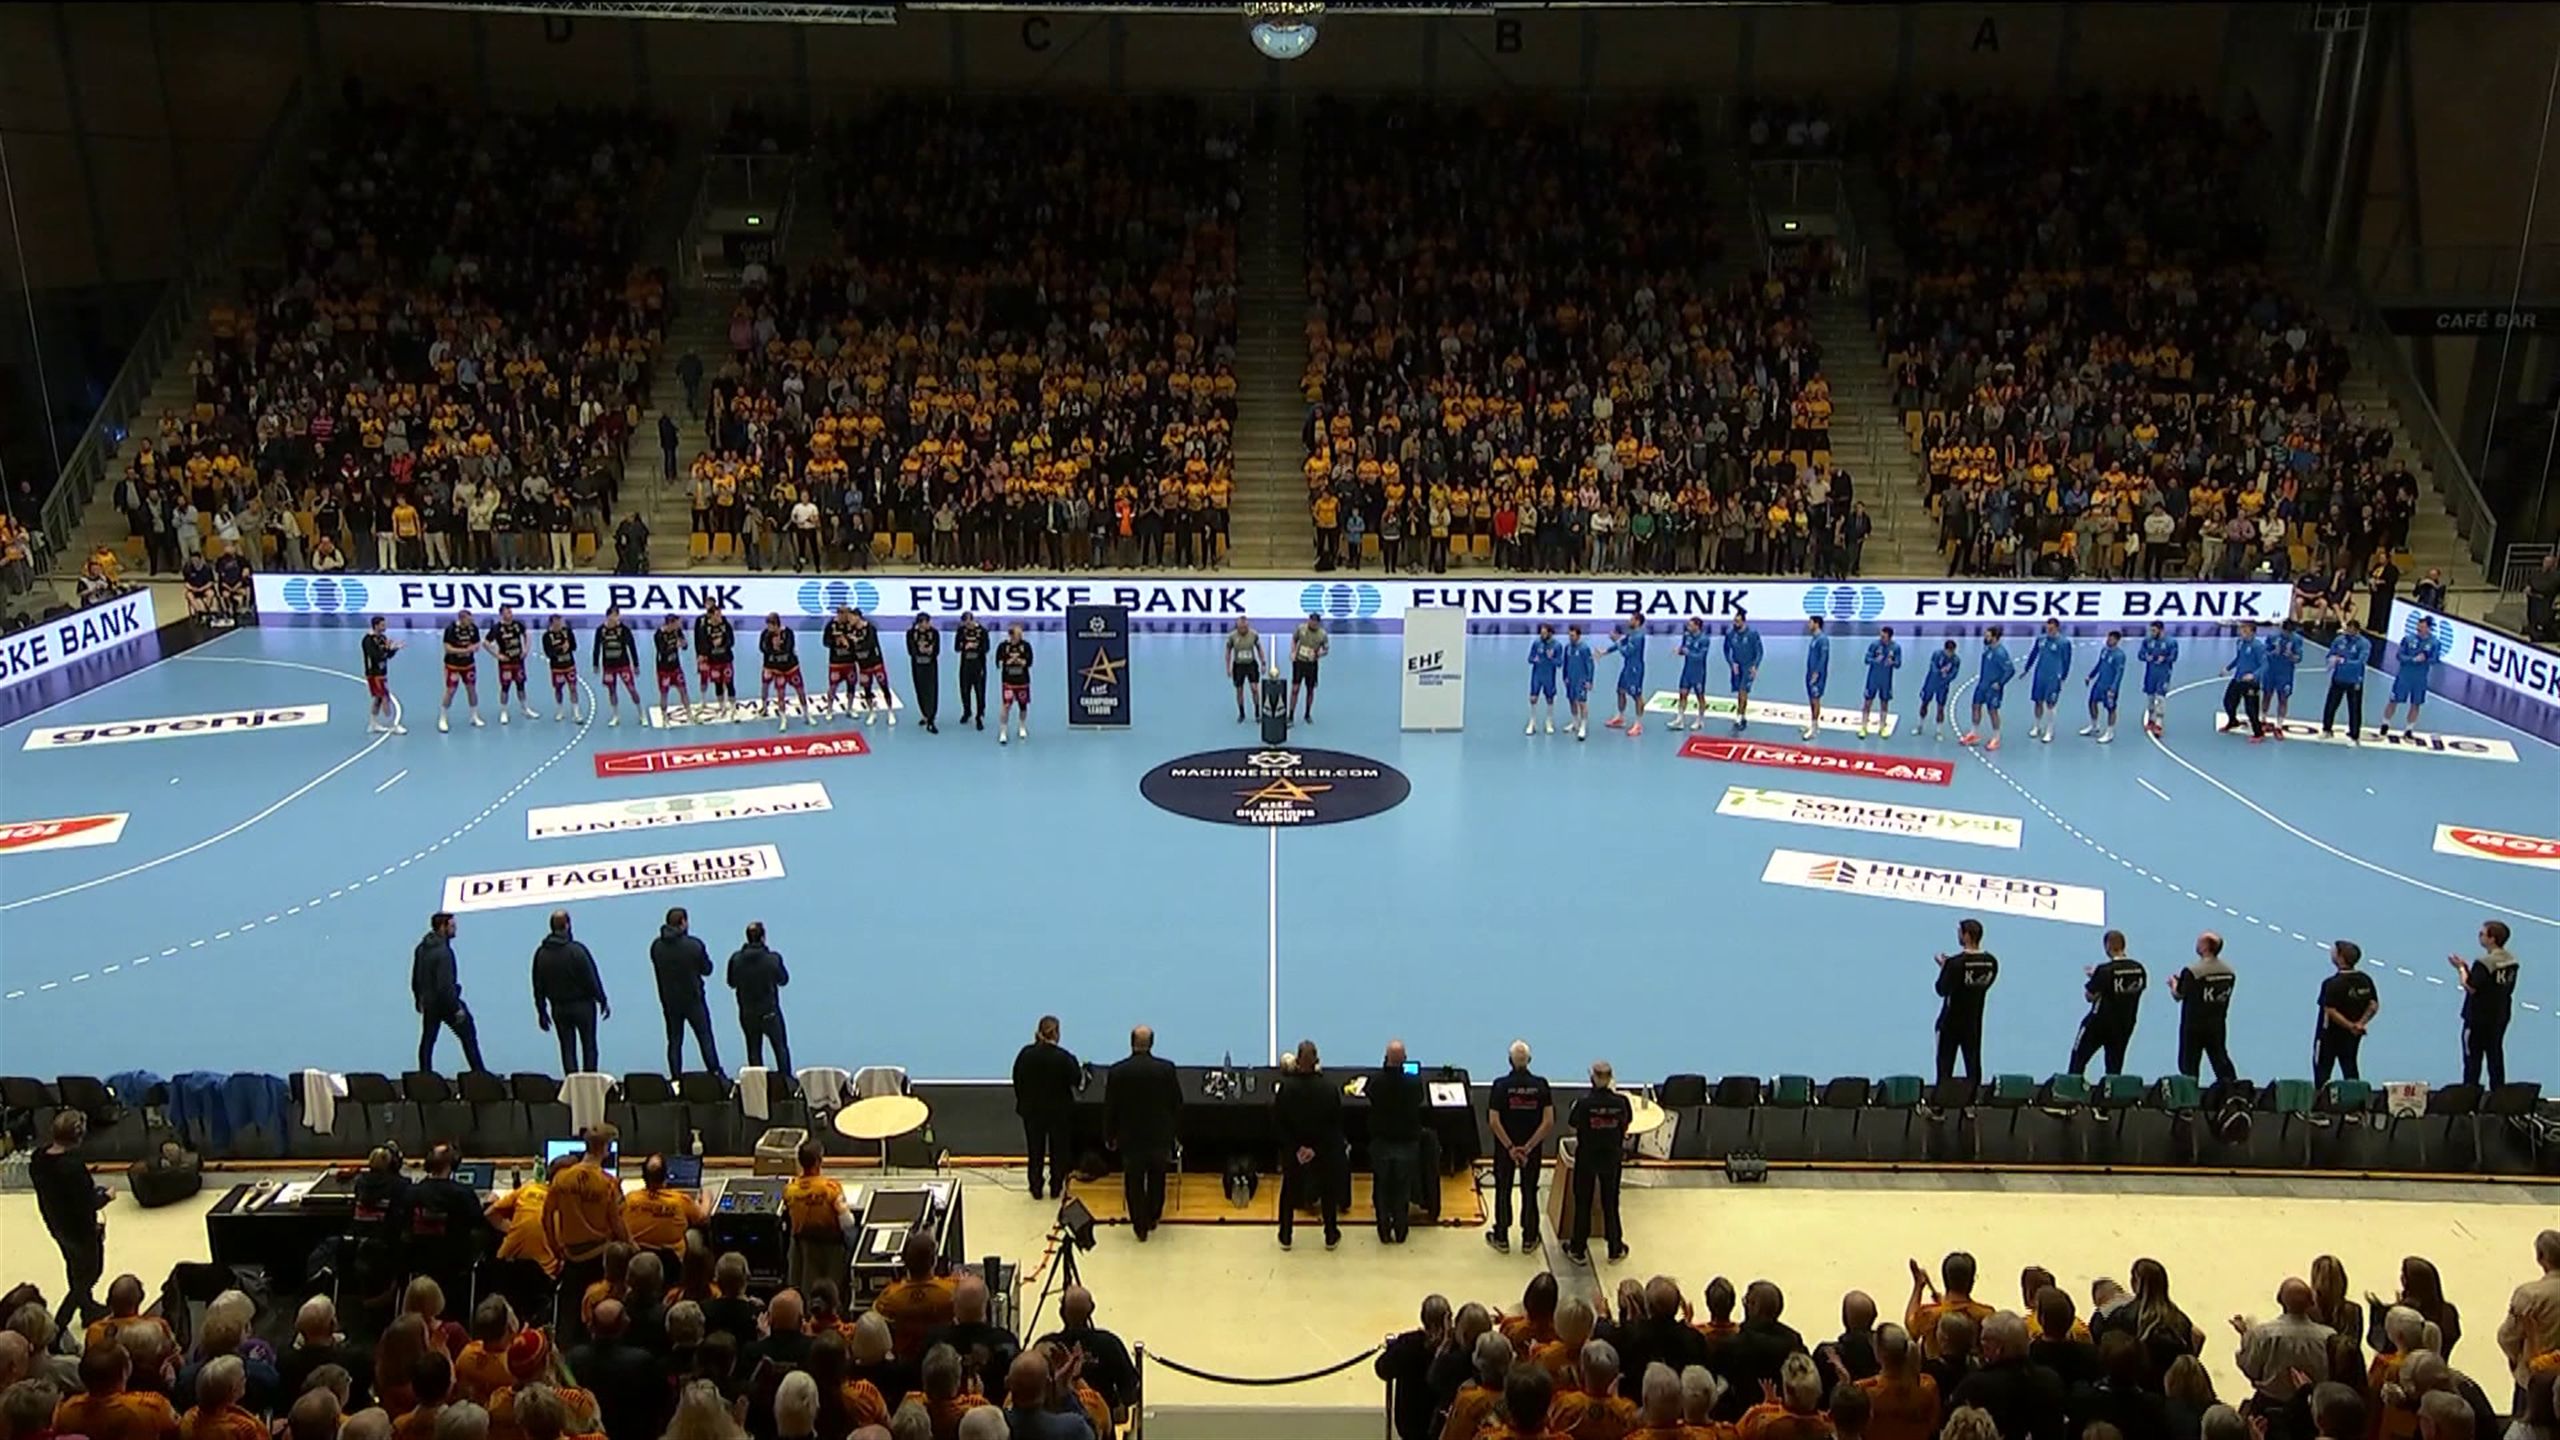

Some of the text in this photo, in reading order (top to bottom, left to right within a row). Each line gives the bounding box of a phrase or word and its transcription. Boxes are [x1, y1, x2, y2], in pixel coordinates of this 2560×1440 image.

[1023, 17, 1050, 51] C
[1497, 20, 1523, 52] B
[1973, 17, 1999, 52] A
[2436, 309, 2537, 328] CAFÉ BAR
[400, 582, 743, 610] FYNSKE BANK
[910, 586, 1246, 613] FYNSKE BANK
[1413, 588, 1749, 615] FYNSKE BANK
[1916, 591, 2262, 617] FYNSKE BANK
[58, 602, 140, 657] BANK
[1408, 650, 1444, 670] EHF
[53, 710, 305, 744] gorenje
[1171, 768, 1379, 778] MACHINESEEKER.COM
[536, 800, 826, 836] FYNSKE BANK
[472, 852, 755, 896] DET FAGLIGE HUS
[1869, 863, 2059, 897] HUMLEBO
[1866, 876, 2056, 911] GRUPPEN
